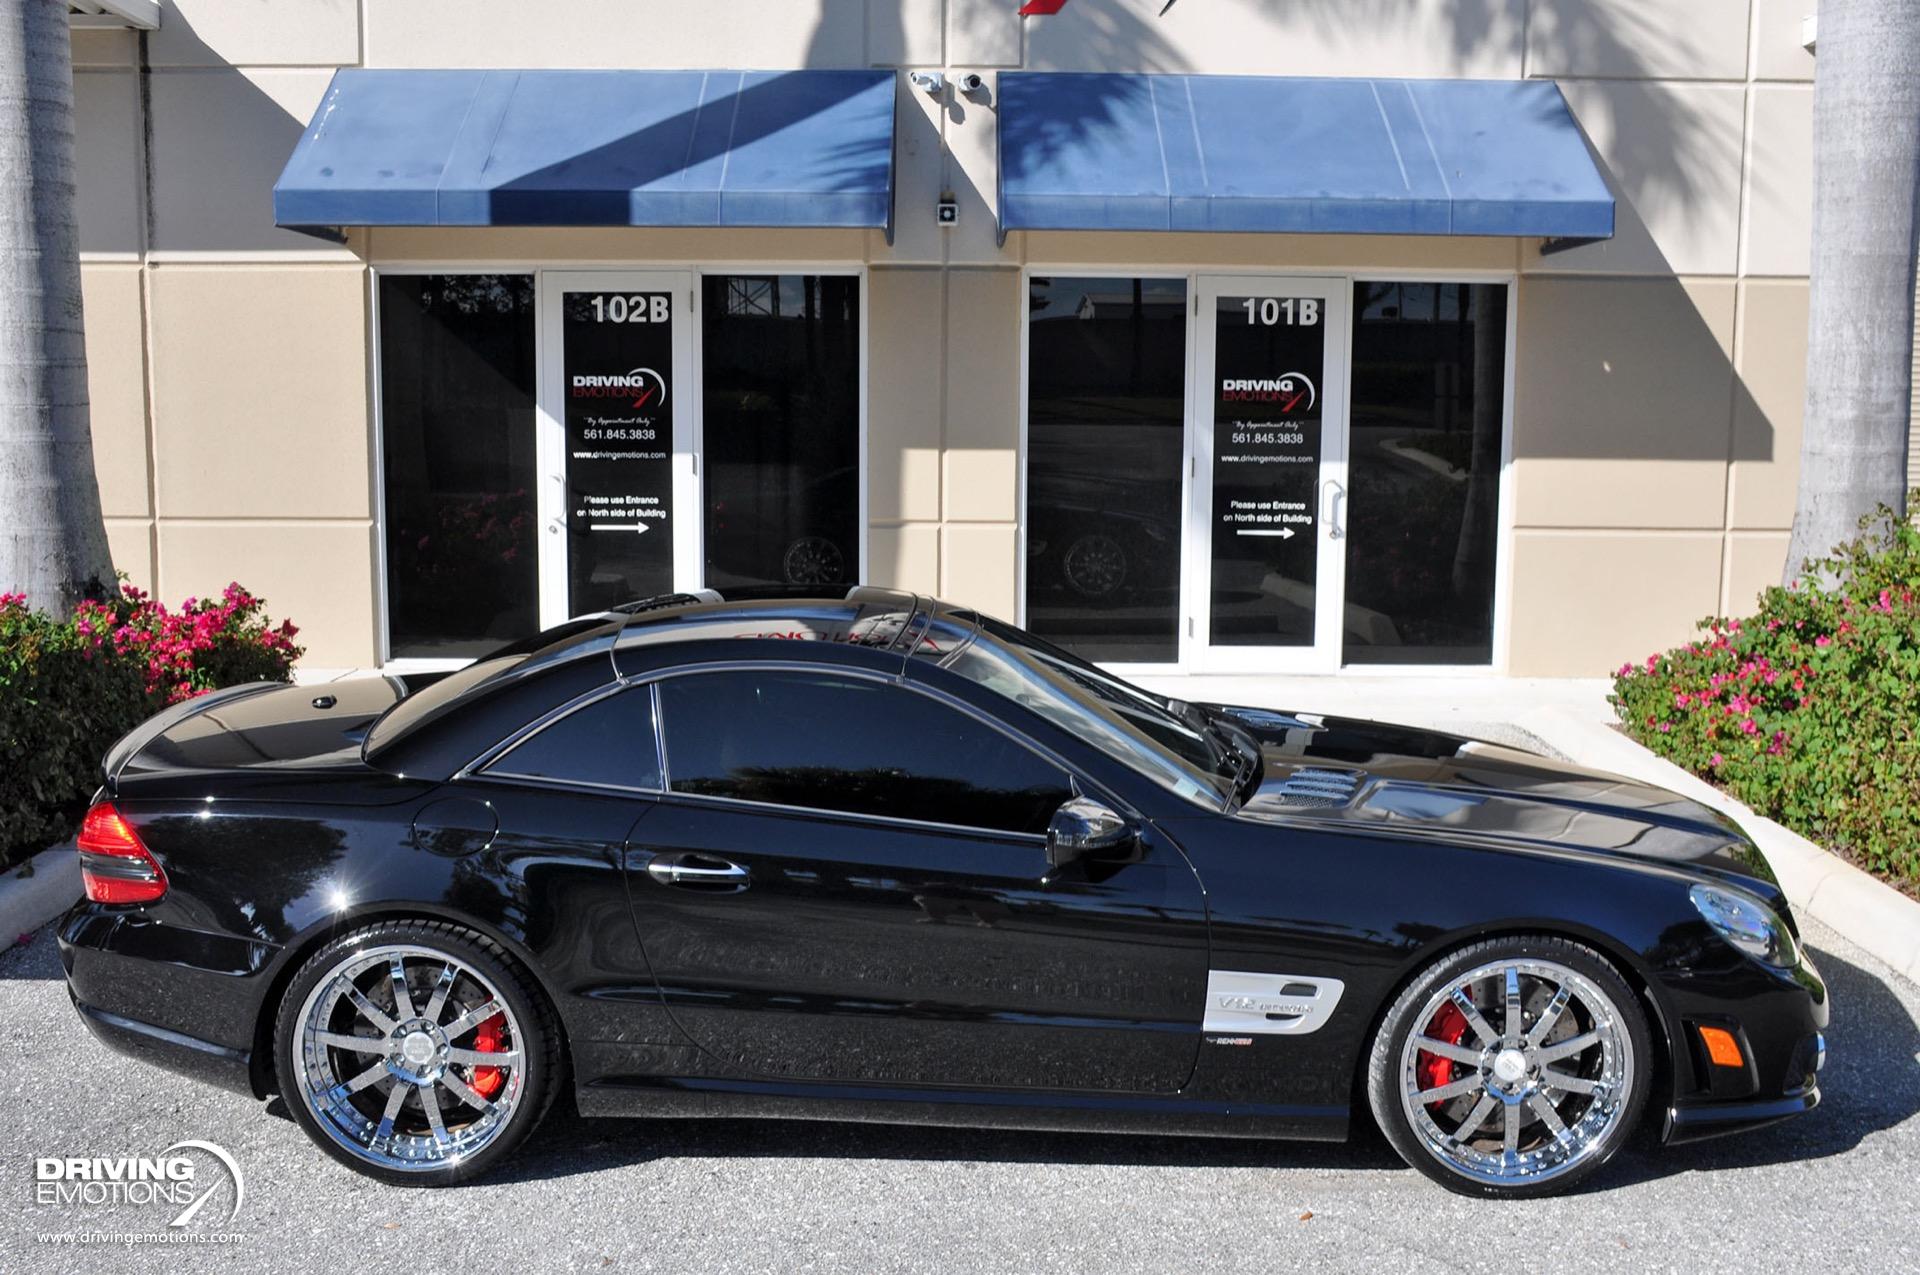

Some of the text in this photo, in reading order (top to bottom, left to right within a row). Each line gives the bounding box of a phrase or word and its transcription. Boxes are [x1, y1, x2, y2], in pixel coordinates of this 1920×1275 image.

[591, 295, 669, 323] 102B
[1243, 298, 1318, 326] 101B
[573, 376, 644, 387] DRIVING
[1223, 380, 1294, 391] DRIVING
[573, 387, 644, 398] EMOTIONS
[1223, 391, 1294, 401] EMOTIONS
[584, 429, 656, 440] 561.845.3838
[1232, 433, 1304, 444] 561.845.3838
[573, 451, 666, 461] www.drivingemotions.com
[1221, 455, 1314, 464] www.drivingemotions.com
[584, 496, 609, 504] Please
[625, 495, 659, 504] Entrance
[1230, 500, 1306, 510] Please use Entrance
[576, 508, 667, 519] on North side of Building
[1223, 513, 1313, 525] on North side of Building
